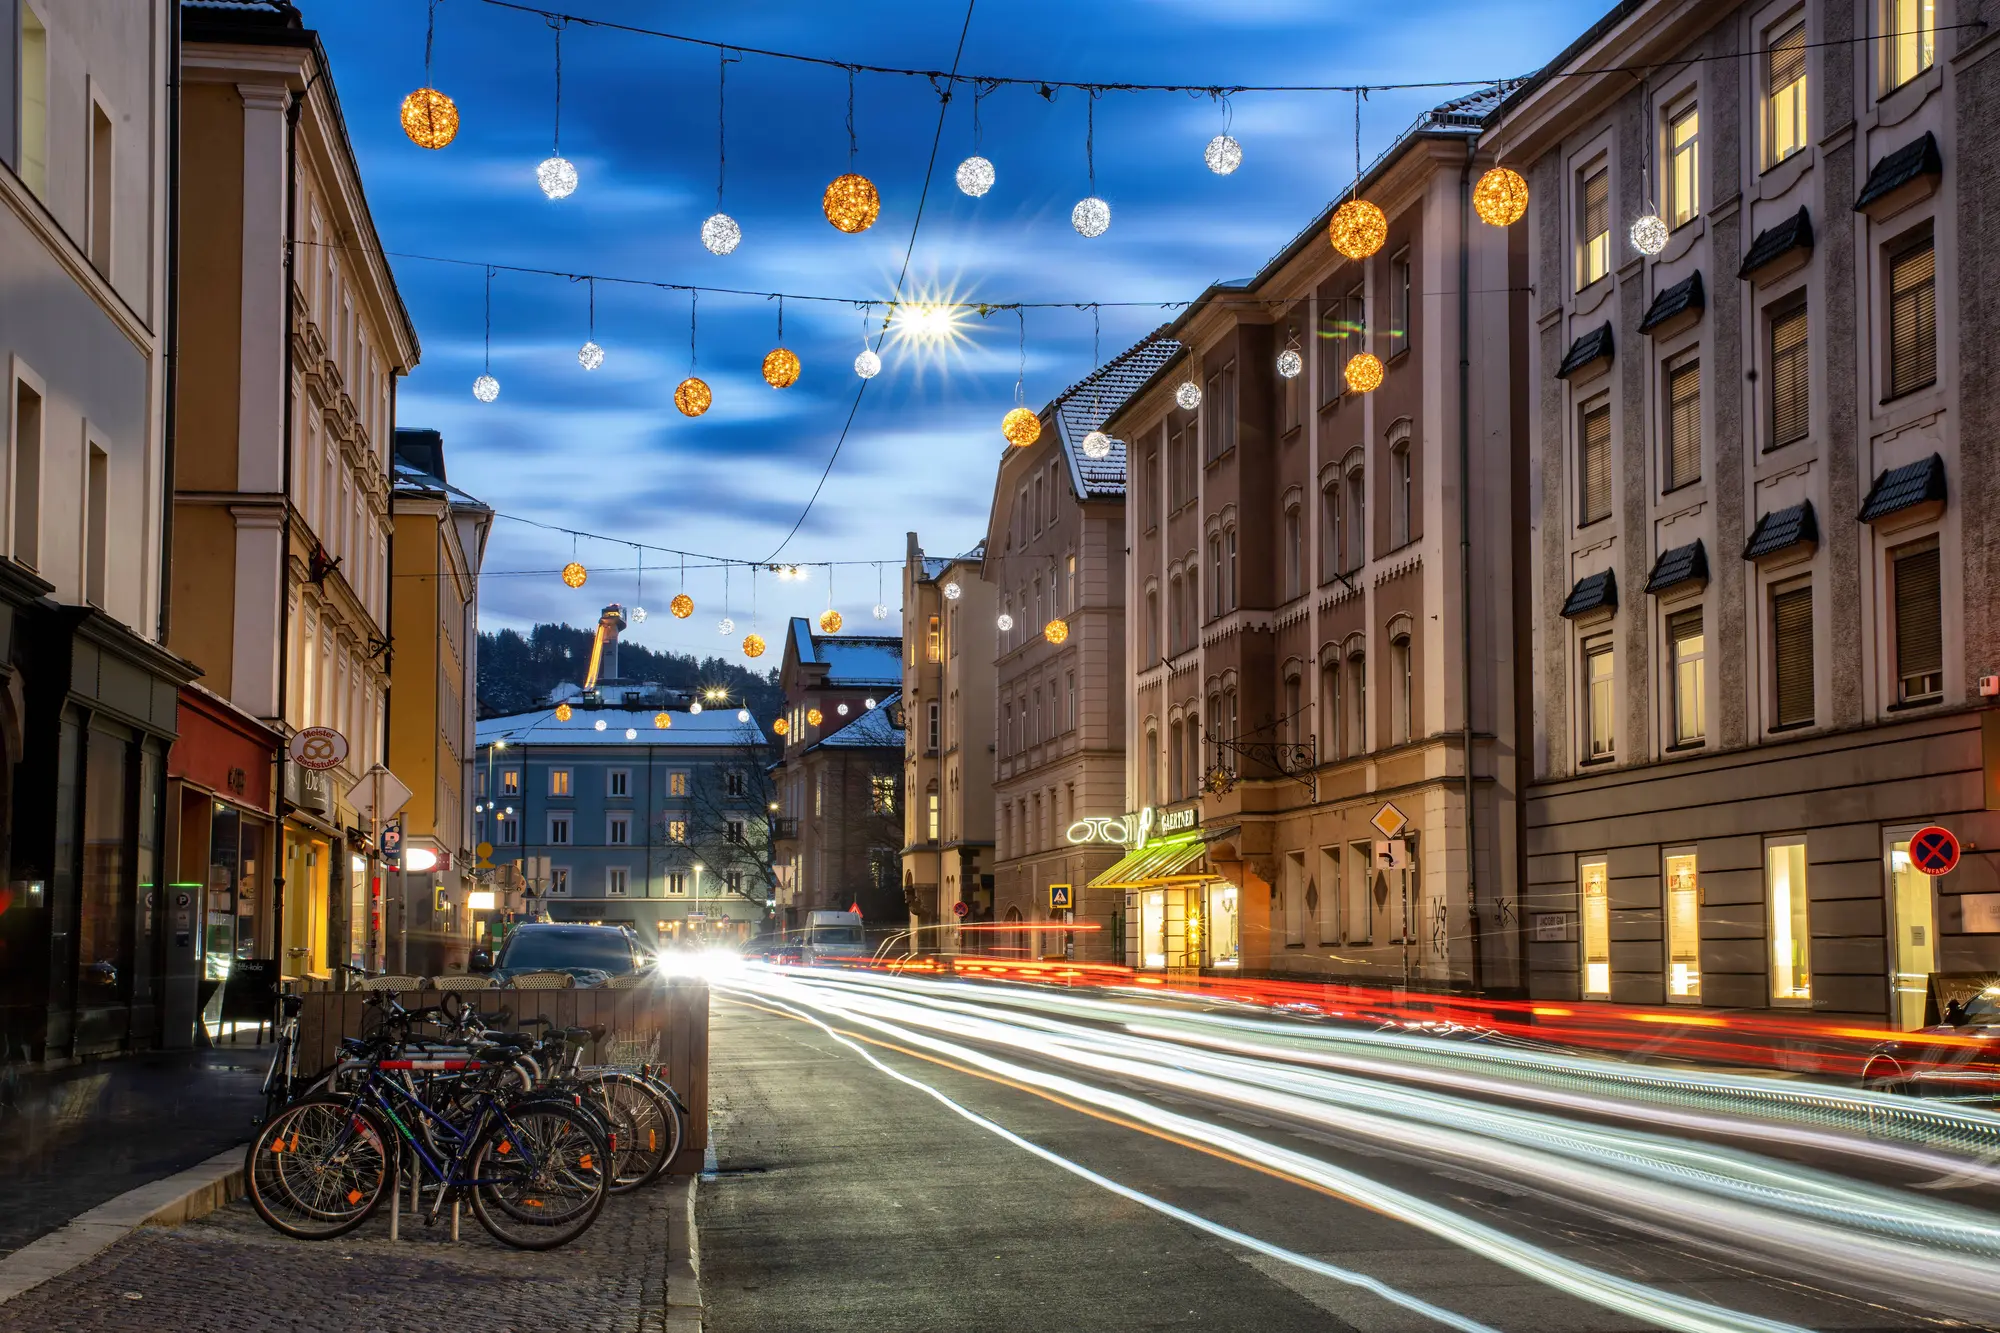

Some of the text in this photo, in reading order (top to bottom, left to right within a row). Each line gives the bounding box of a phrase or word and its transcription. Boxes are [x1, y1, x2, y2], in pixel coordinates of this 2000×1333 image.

[303, 729, 335, 739] Meister
[297, 754, 340, 769] Backstube
[1161, 809, 1194, 832] GAERTNER
[1922, 865, 1949, 875] ANFANG
[179, 896, 187, 905] P
